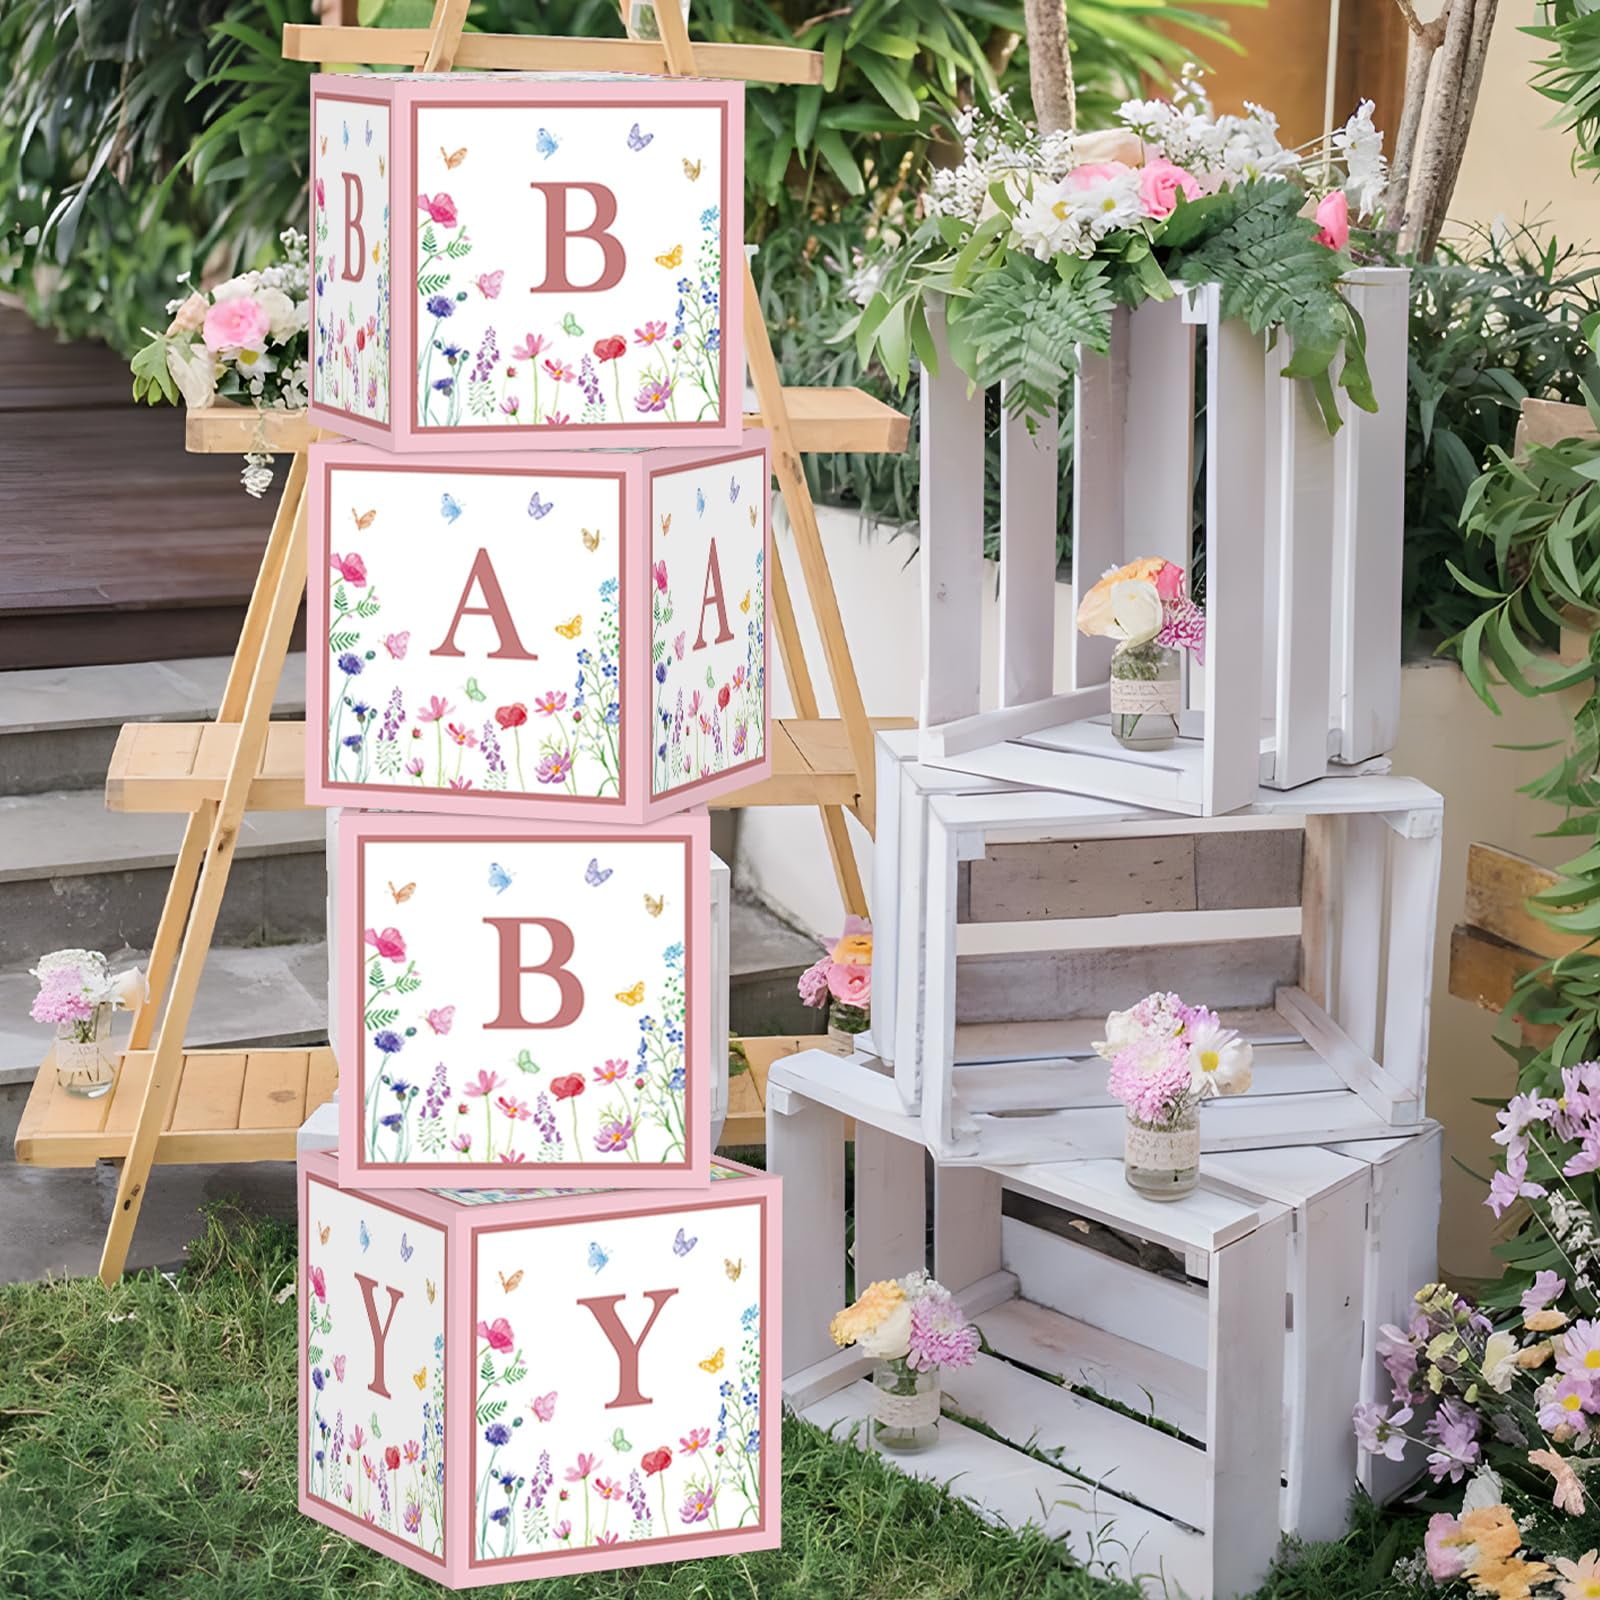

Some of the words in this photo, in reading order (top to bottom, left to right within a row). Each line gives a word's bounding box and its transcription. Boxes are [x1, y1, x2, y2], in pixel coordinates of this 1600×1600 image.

[341, 171, 366, 283] B
[529, 182, 627, 294] B
[429, 547, 539, 661] A
[692, 537, 735, 651] A
[482, 916, 585, 1030] B
[353, 1272, 405, 1400] Y
[576, 1287, 680, 1410] Y
